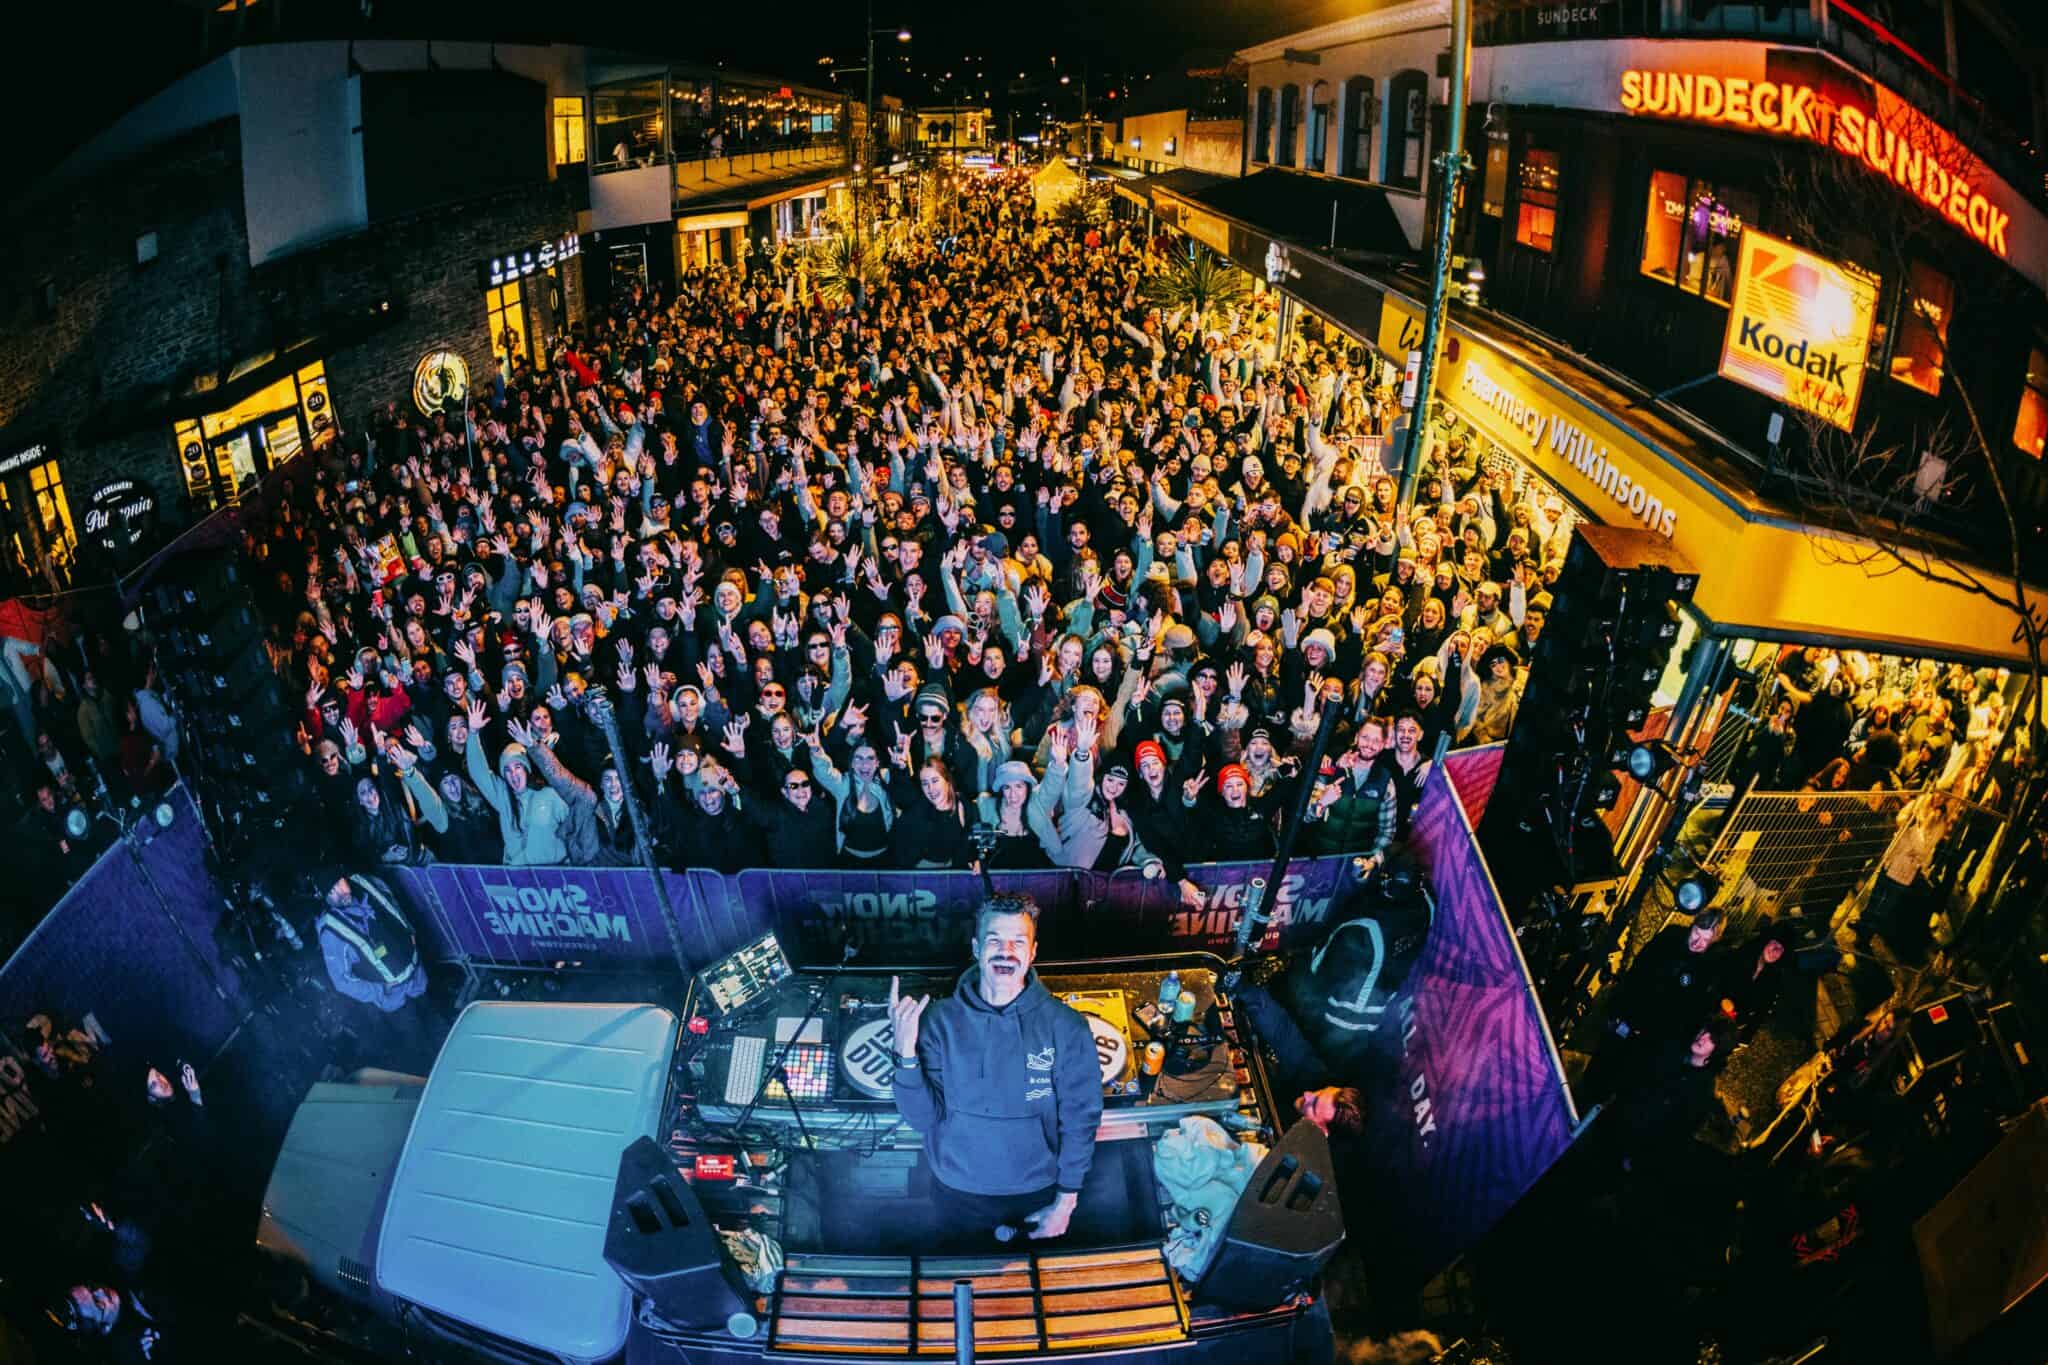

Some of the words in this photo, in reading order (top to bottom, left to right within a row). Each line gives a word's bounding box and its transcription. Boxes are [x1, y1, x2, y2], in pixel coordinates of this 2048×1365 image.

[1537, 7, 1599, 25] SUNDECK
[1620, 69, 1812, 137] SUNDECK
[1835, 104, 2010, 257] SUNDECK
[1738, 315, 1850, 390] Kodak
[1462, 359, 1548, 448] Pharmacy
[1550, 412, 1678, 539] Wilkinsons
